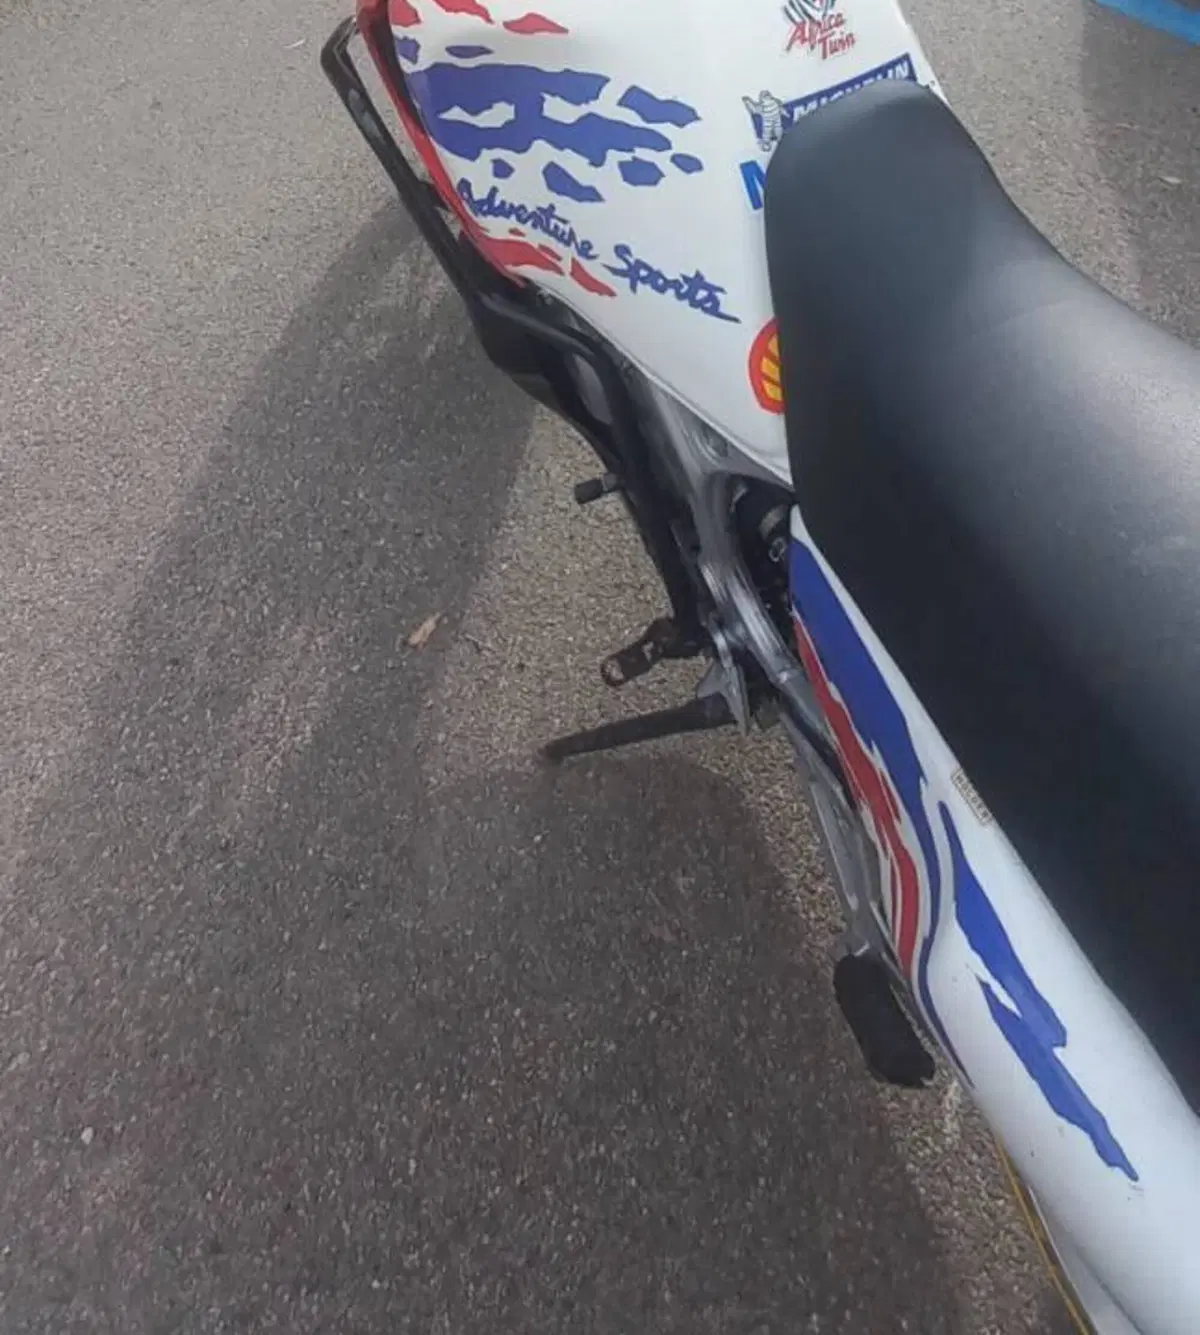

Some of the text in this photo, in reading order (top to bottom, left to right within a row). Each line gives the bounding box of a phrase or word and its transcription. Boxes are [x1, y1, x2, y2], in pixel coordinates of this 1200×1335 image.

[818, 31, 856, 60] Twin
[457, 177, 741, 323] Adventure Sports
